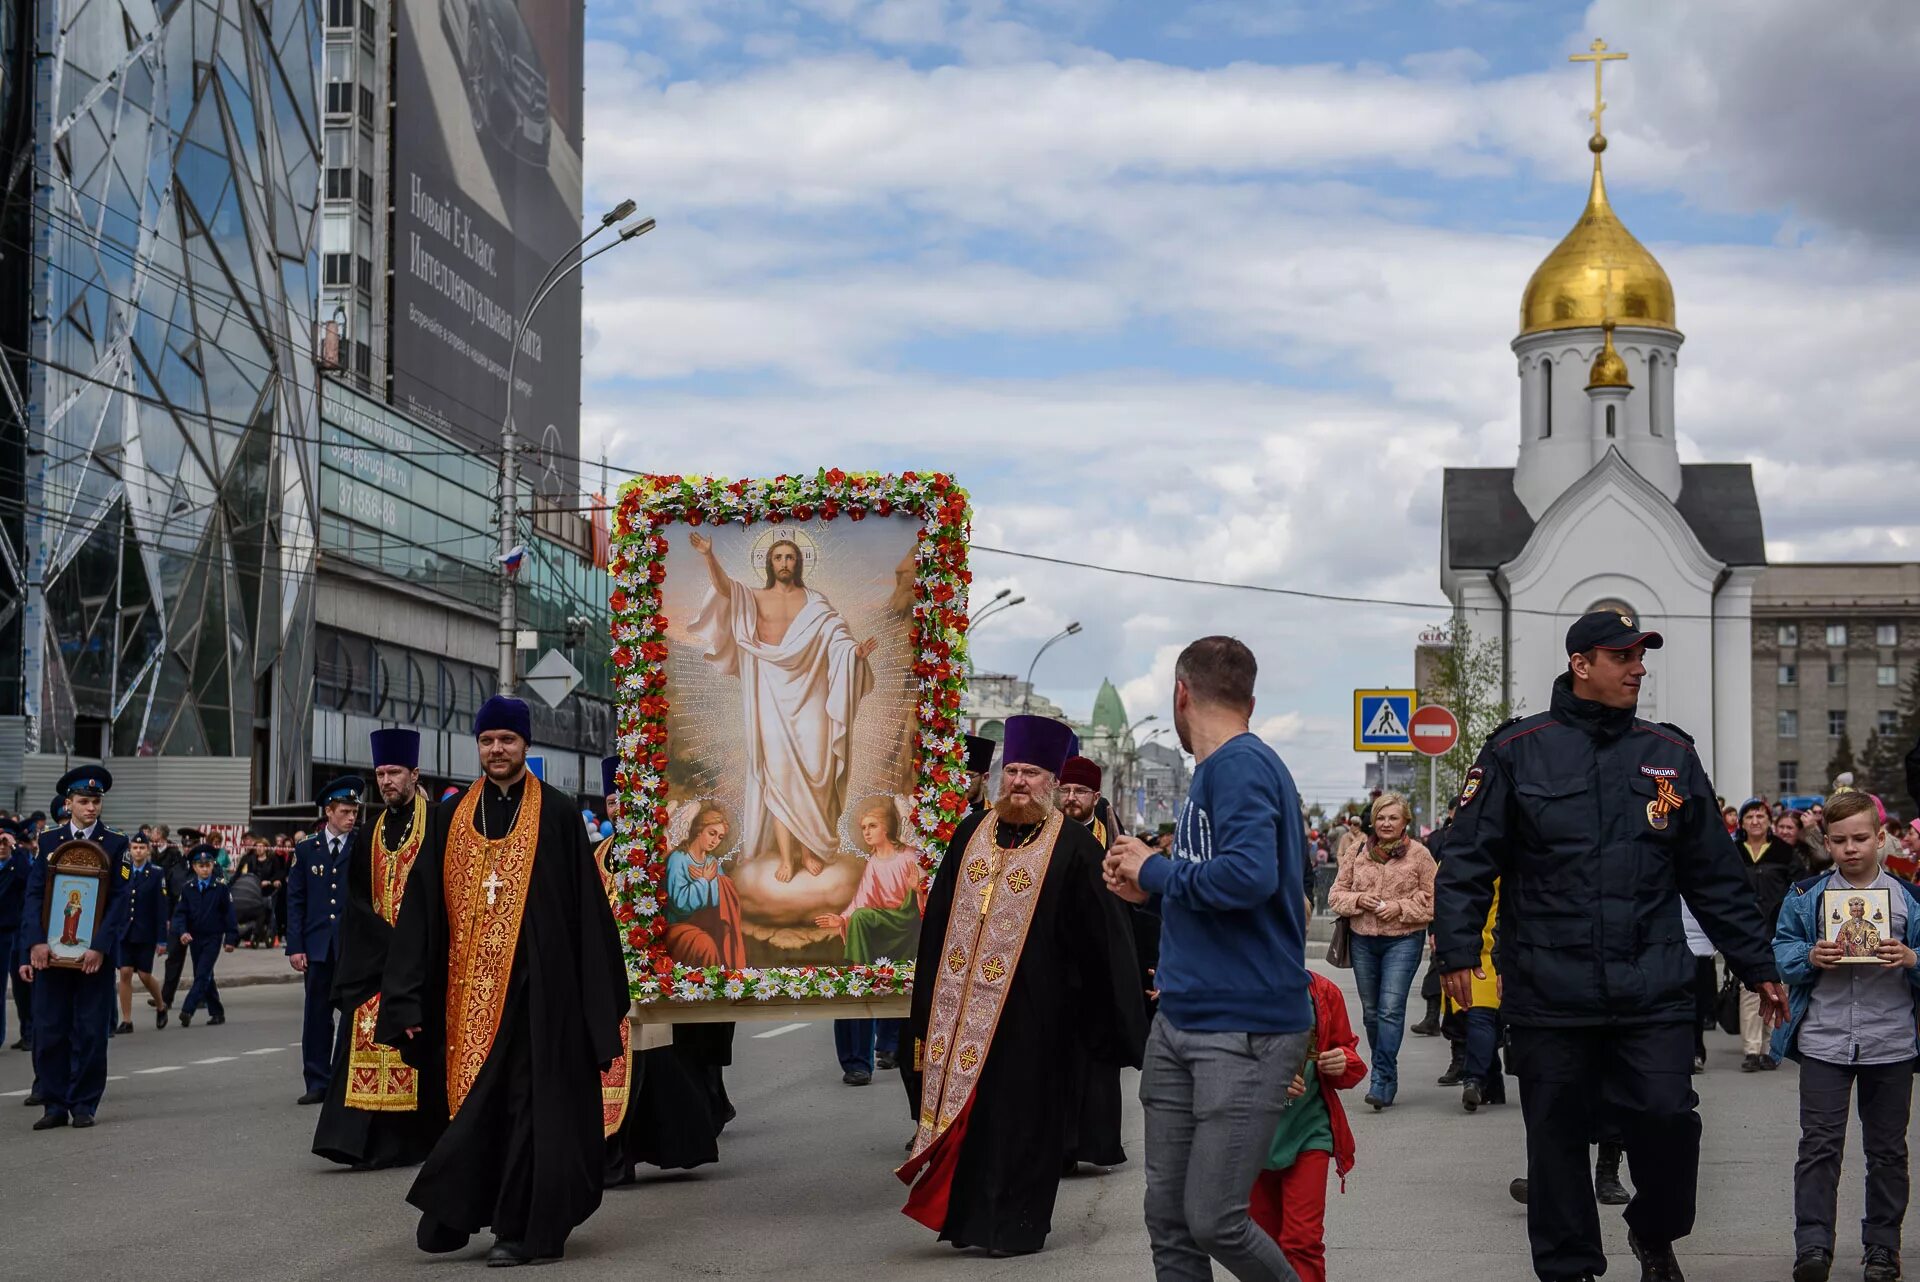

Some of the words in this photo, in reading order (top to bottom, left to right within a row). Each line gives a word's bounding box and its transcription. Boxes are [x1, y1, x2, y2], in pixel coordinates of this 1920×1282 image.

[410, 173, 451, 241] Новый
[453, 206, 497, 278] Е-Класс.
[410, 232, 512, 342] Интеллектуальная
[331, 435, 407, 488] SpaceStructure.ru
[338, 481, 396, 526] 37-556-86
[1640, 766, 1676, 776] ПОЛИЦИЯ
